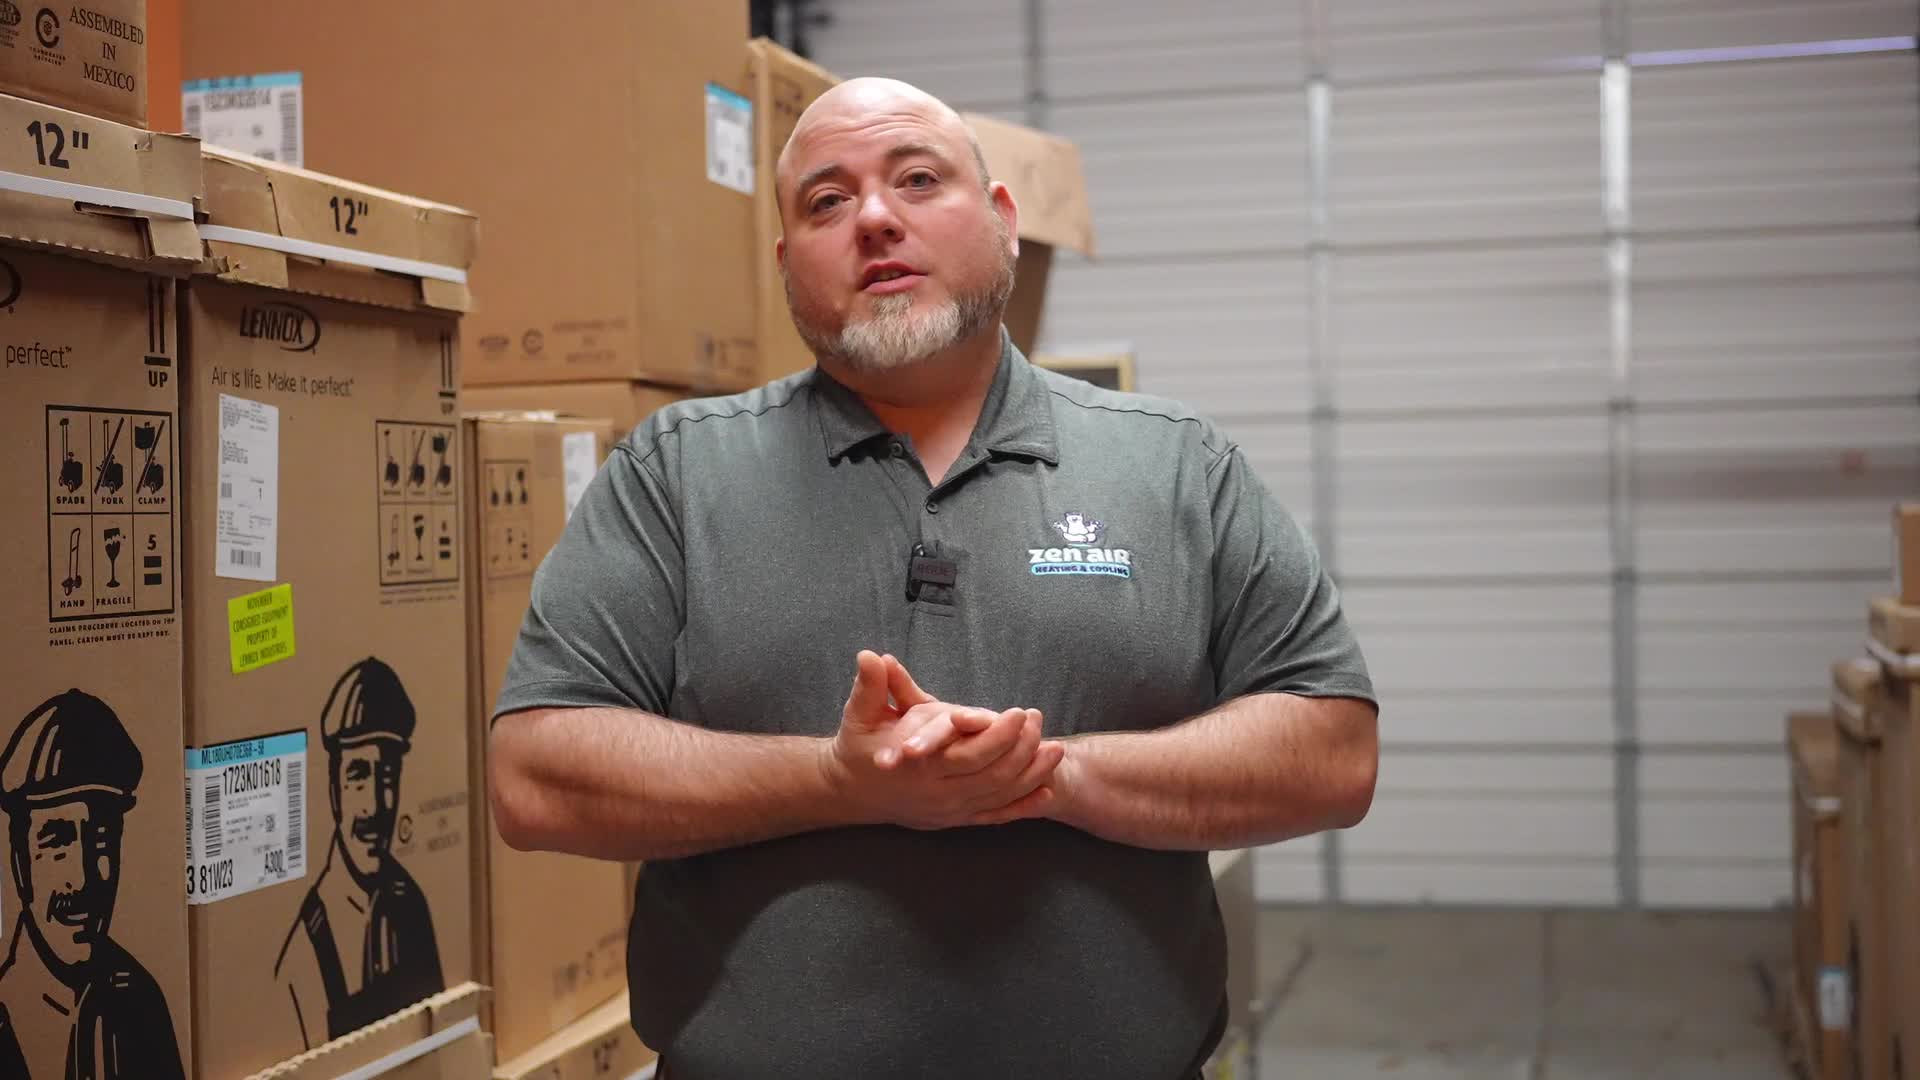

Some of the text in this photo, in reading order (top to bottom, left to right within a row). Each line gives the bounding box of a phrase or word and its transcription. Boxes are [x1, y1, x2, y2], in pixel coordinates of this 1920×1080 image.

[69, 6, 144, 45] ASSEMBLED
[102, 42, 117, 60] IN
[83, 62, 135, 92] MEXICO
[26, 120, 89, 170] 12"
[329, 196, 368, 236] 12"
[239, 303, 306, 345] LENNOX
[148, 370, 168, 388] UP
[211, 366, 228, 386] Air
[231, 368, 241, 388] is
[267, 372, 297, 393] Make
[56, 496, 85, 504] SPADE
[101, 497, 124, 505] FORK
[138, 497, 167, 505] CLAMP
[147, 534, 157, 551] 5
[1028, 547, 1083, 563] zen
[1035, 565, 1129, 576] HEATING & COOLING
[60, 600, 85, 608] HAND
[96, 597, 132, 606] FRAGILE
[49, 625, 76, 634] CLAIMS
[121, 620, 150, 628] LOCATED
[222, 758, 281, 796] 1723K01618
[200, 859, 233, 894] 81W23
